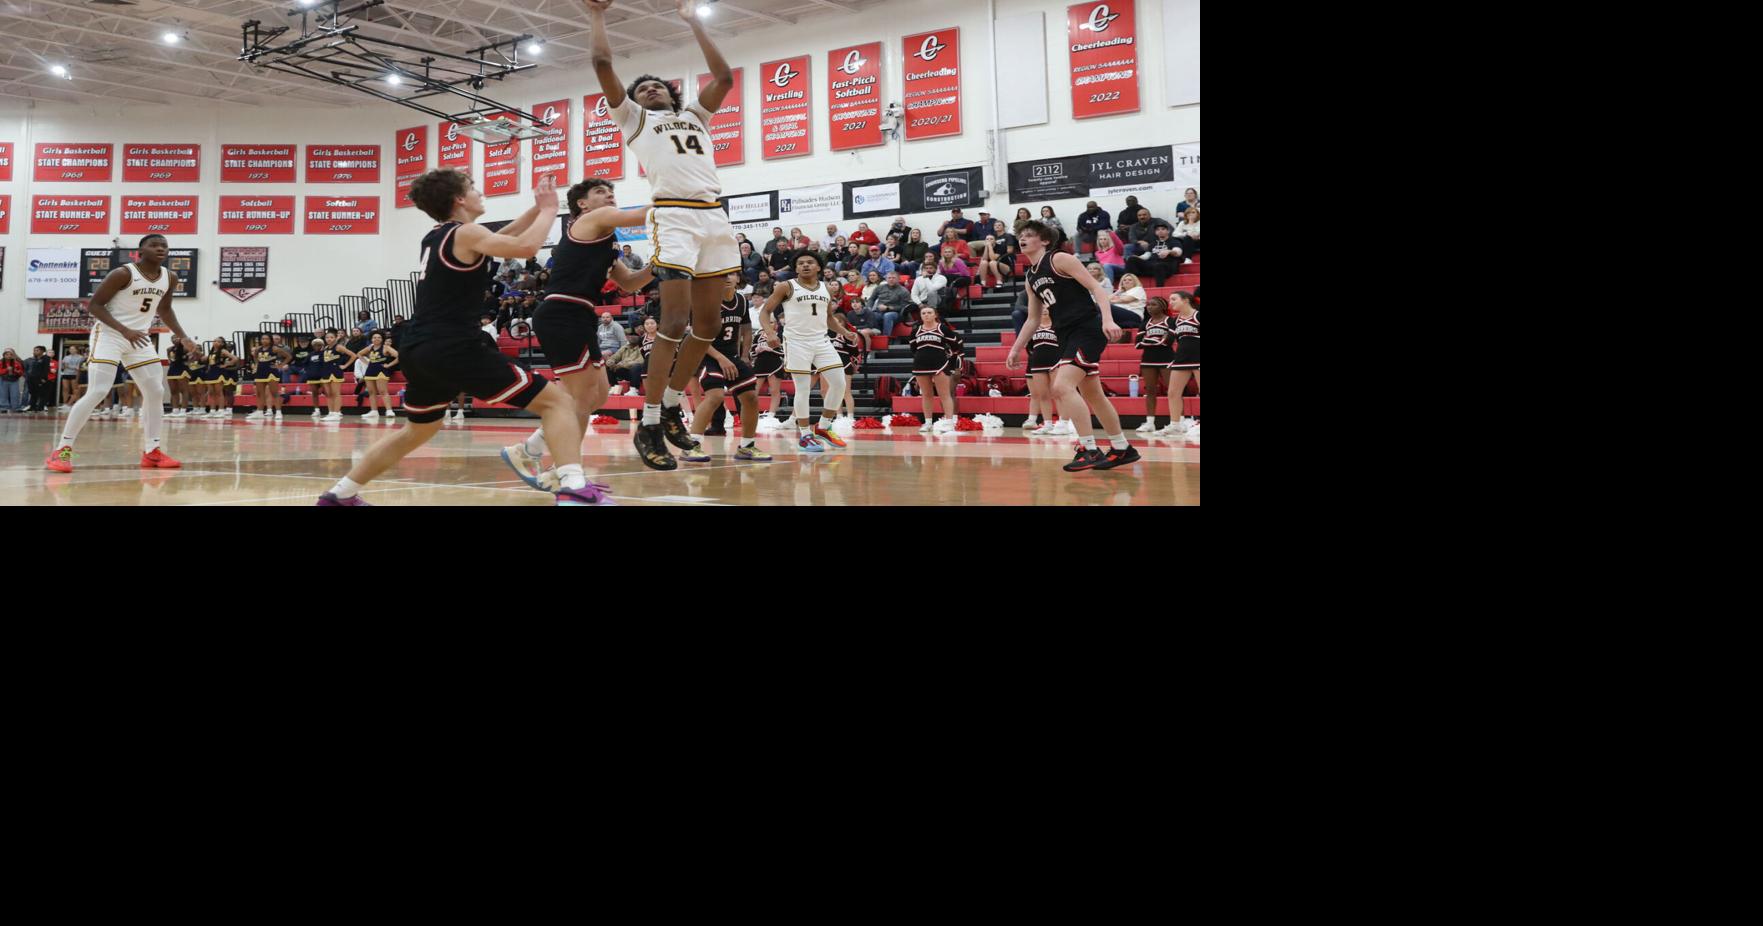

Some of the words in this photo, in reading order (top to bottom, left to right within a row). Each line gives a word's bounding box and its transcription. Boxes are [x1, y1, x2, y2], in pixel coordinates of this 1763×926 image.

[1072, 36, 1134, 53] Cheerleading
[1073, 63, 1097, 73] REGION
[906, 67, 957, 81] Cheerleading
[832, 75, 876, 90] Fast-Pitch
[766, 90, 804, 102] Wrestling
[835, 86, 872, 99] Softball
[1089, 91, 1120, 103] 2022
[911, 114, 953, 127] 2020/21
[842, 121, 867, 131] 2021
[586, 126, 619, 137] Traditional
[534, 135, 566, 146] Traditional
[598, 134, 613, 142] Dual
[441, 142, 467, 152] Fast-Pitch
[545, 143, 560, 151] Dual
[586, 142, 620, 152] Champions
[670, 134, 705, 155] 14
[775, 143, 796, 152] 2021
[43, 147, 62, 155] Girls
[64, 147, 106, 155] Basketball
[227, 148, 246, 156] Girls
[248, 148, 289, 156] Basketball
[443, 151, 465, 160] Softball
[534, 150, 566, 161] Champions
[38, 158, 60, 167] STATE
[62, 158, 108, 167] CHAMPIONS
[127, 159, 149, 167] STATE
[151, 159, 196, 167] CHAMPIONS
[410, 154, 423, 162] Track
[224, 159, 246, 168] STATE
[248, 159, 294, 168] CHAMPIONS
[310, 160, 331, 169] STATE
[333, 160, 377, 169] CHAMPIONS
[1091, 162, 1113, 172] JYL
[1116, 155, 1168, 169] CRAVEN
[1035, 165, 1060, 176] 2112
[1099, 172, 1121, 180] HAIR
[1125, 168, 1160, 178] DESIGN
[492, 180, 509, 188] 2019
[1107, 185, 1153, 195] jylcraven.com
[38, 199, 58, 207] Girls
[60, 199, 103, 207] Basketball
[240, 199, 272, 207] Softball
[818, 194, 841, 202] Hudson
[926, 193, 967, 203] CONSTRUCTION
[128, 199, 146, 208] Boys
[149, 199, 190, 208] Basketball
[745, 201, 769, 210] HELLER
[36, 211, 58, 219] STATE
[60, 211, 106, 219] RUNNER-UP
[124, 211, 147, 219] STATE
[148, 211, 193, 219] RUNNER-UP
[223, 211, 244, 219] STATE
[246, 211, 291, 219] RUNNER-UP
[309, 211, 329, 220] STATE
[332, 211, 375, 220] RUNNER-UP
[172, 258, 191, 271] 27
[140, 297, 153, 313] 5
[811, 303, 818, 316] 1
[723, 326, 734, 341] 3
